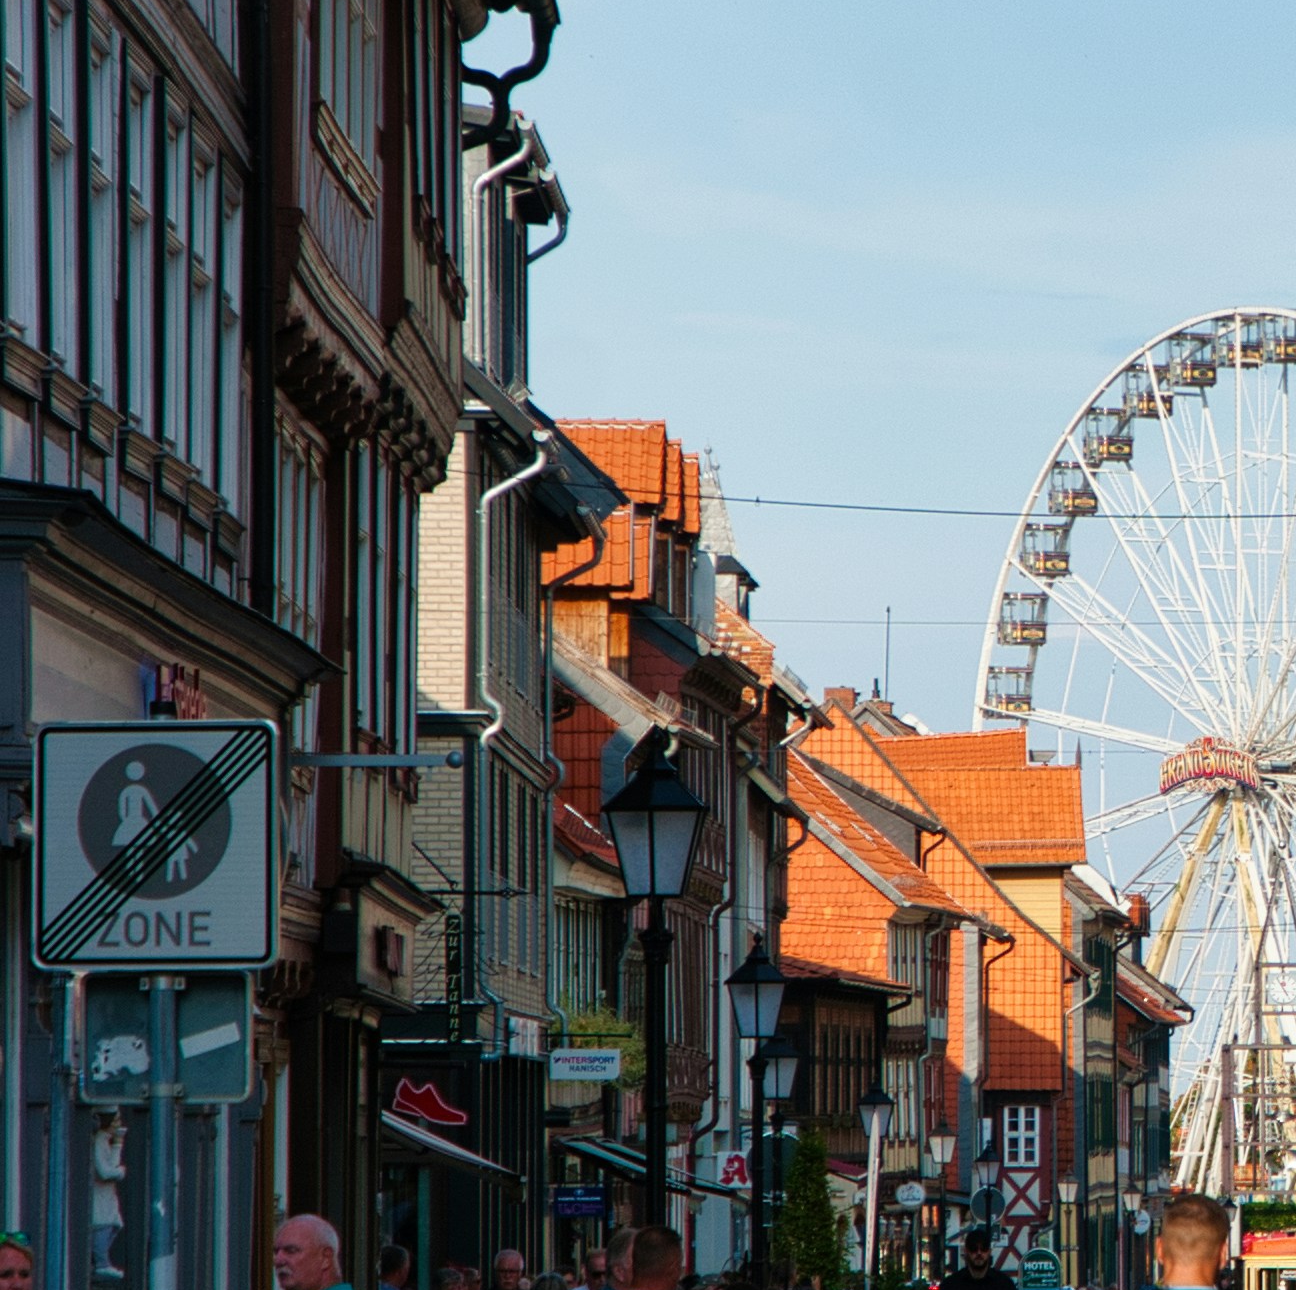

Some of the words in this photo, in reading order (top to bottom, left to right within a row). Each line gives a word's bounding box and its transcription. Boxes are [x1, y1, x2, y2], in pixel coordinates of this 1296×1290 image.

[97, 911, 211, 947] ZONE
[446, 918, 461, 961] Zur
[446, 973, 461, 1042] Tanne
[561, 1056, 615, 1064] INTERSPORT
[1024, 1262, 1055, 1270] HOTEL
